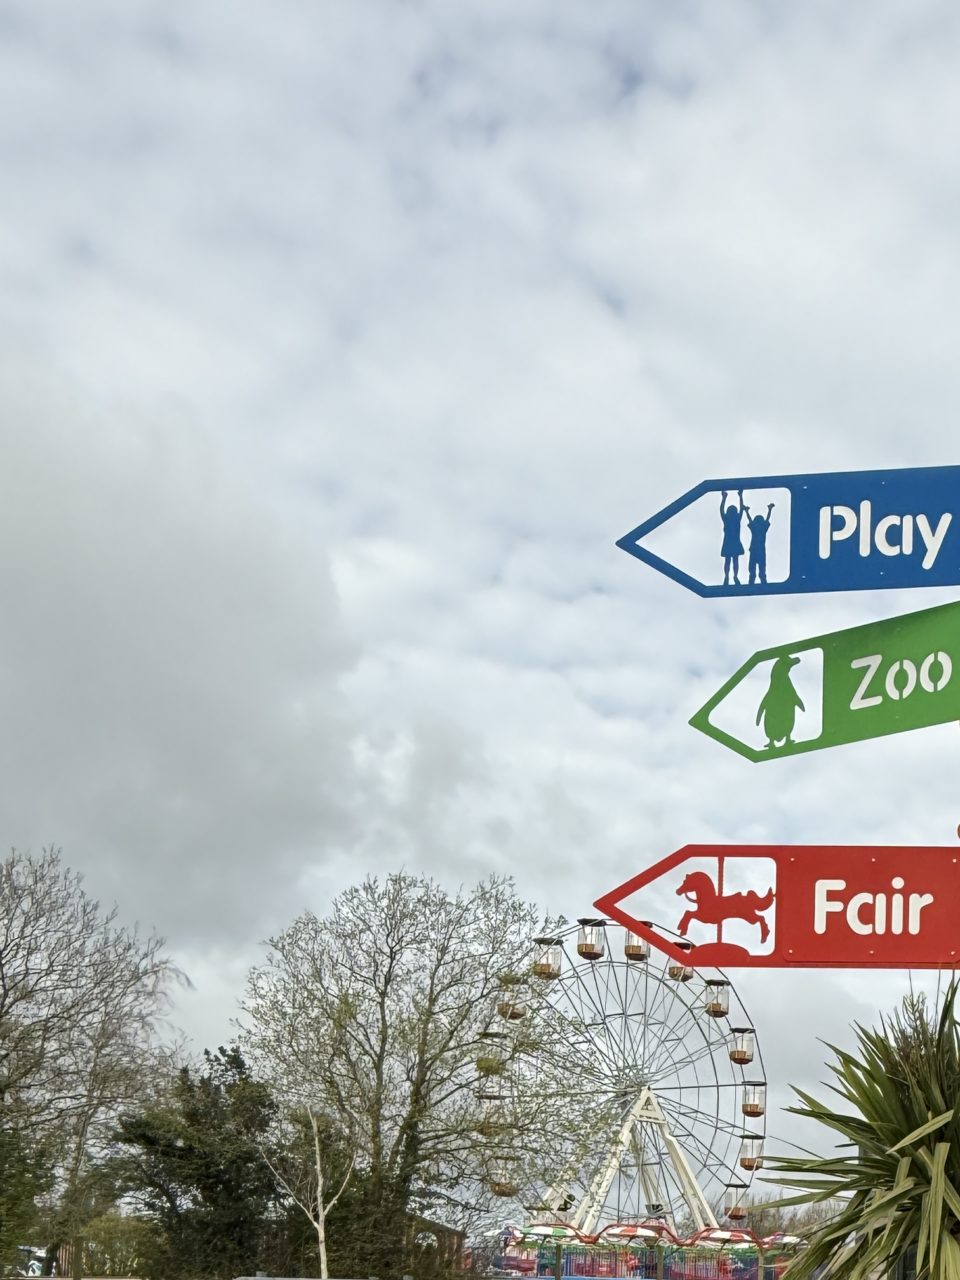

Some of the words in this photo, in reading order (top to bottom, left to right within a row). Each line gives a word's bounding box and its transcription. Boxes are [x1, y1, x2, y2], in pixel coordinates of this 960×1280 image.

[818, 499, 953, 570] Play
[849, 650, 953, 711] Zoo
[813, 876, 934, 936] Fair
